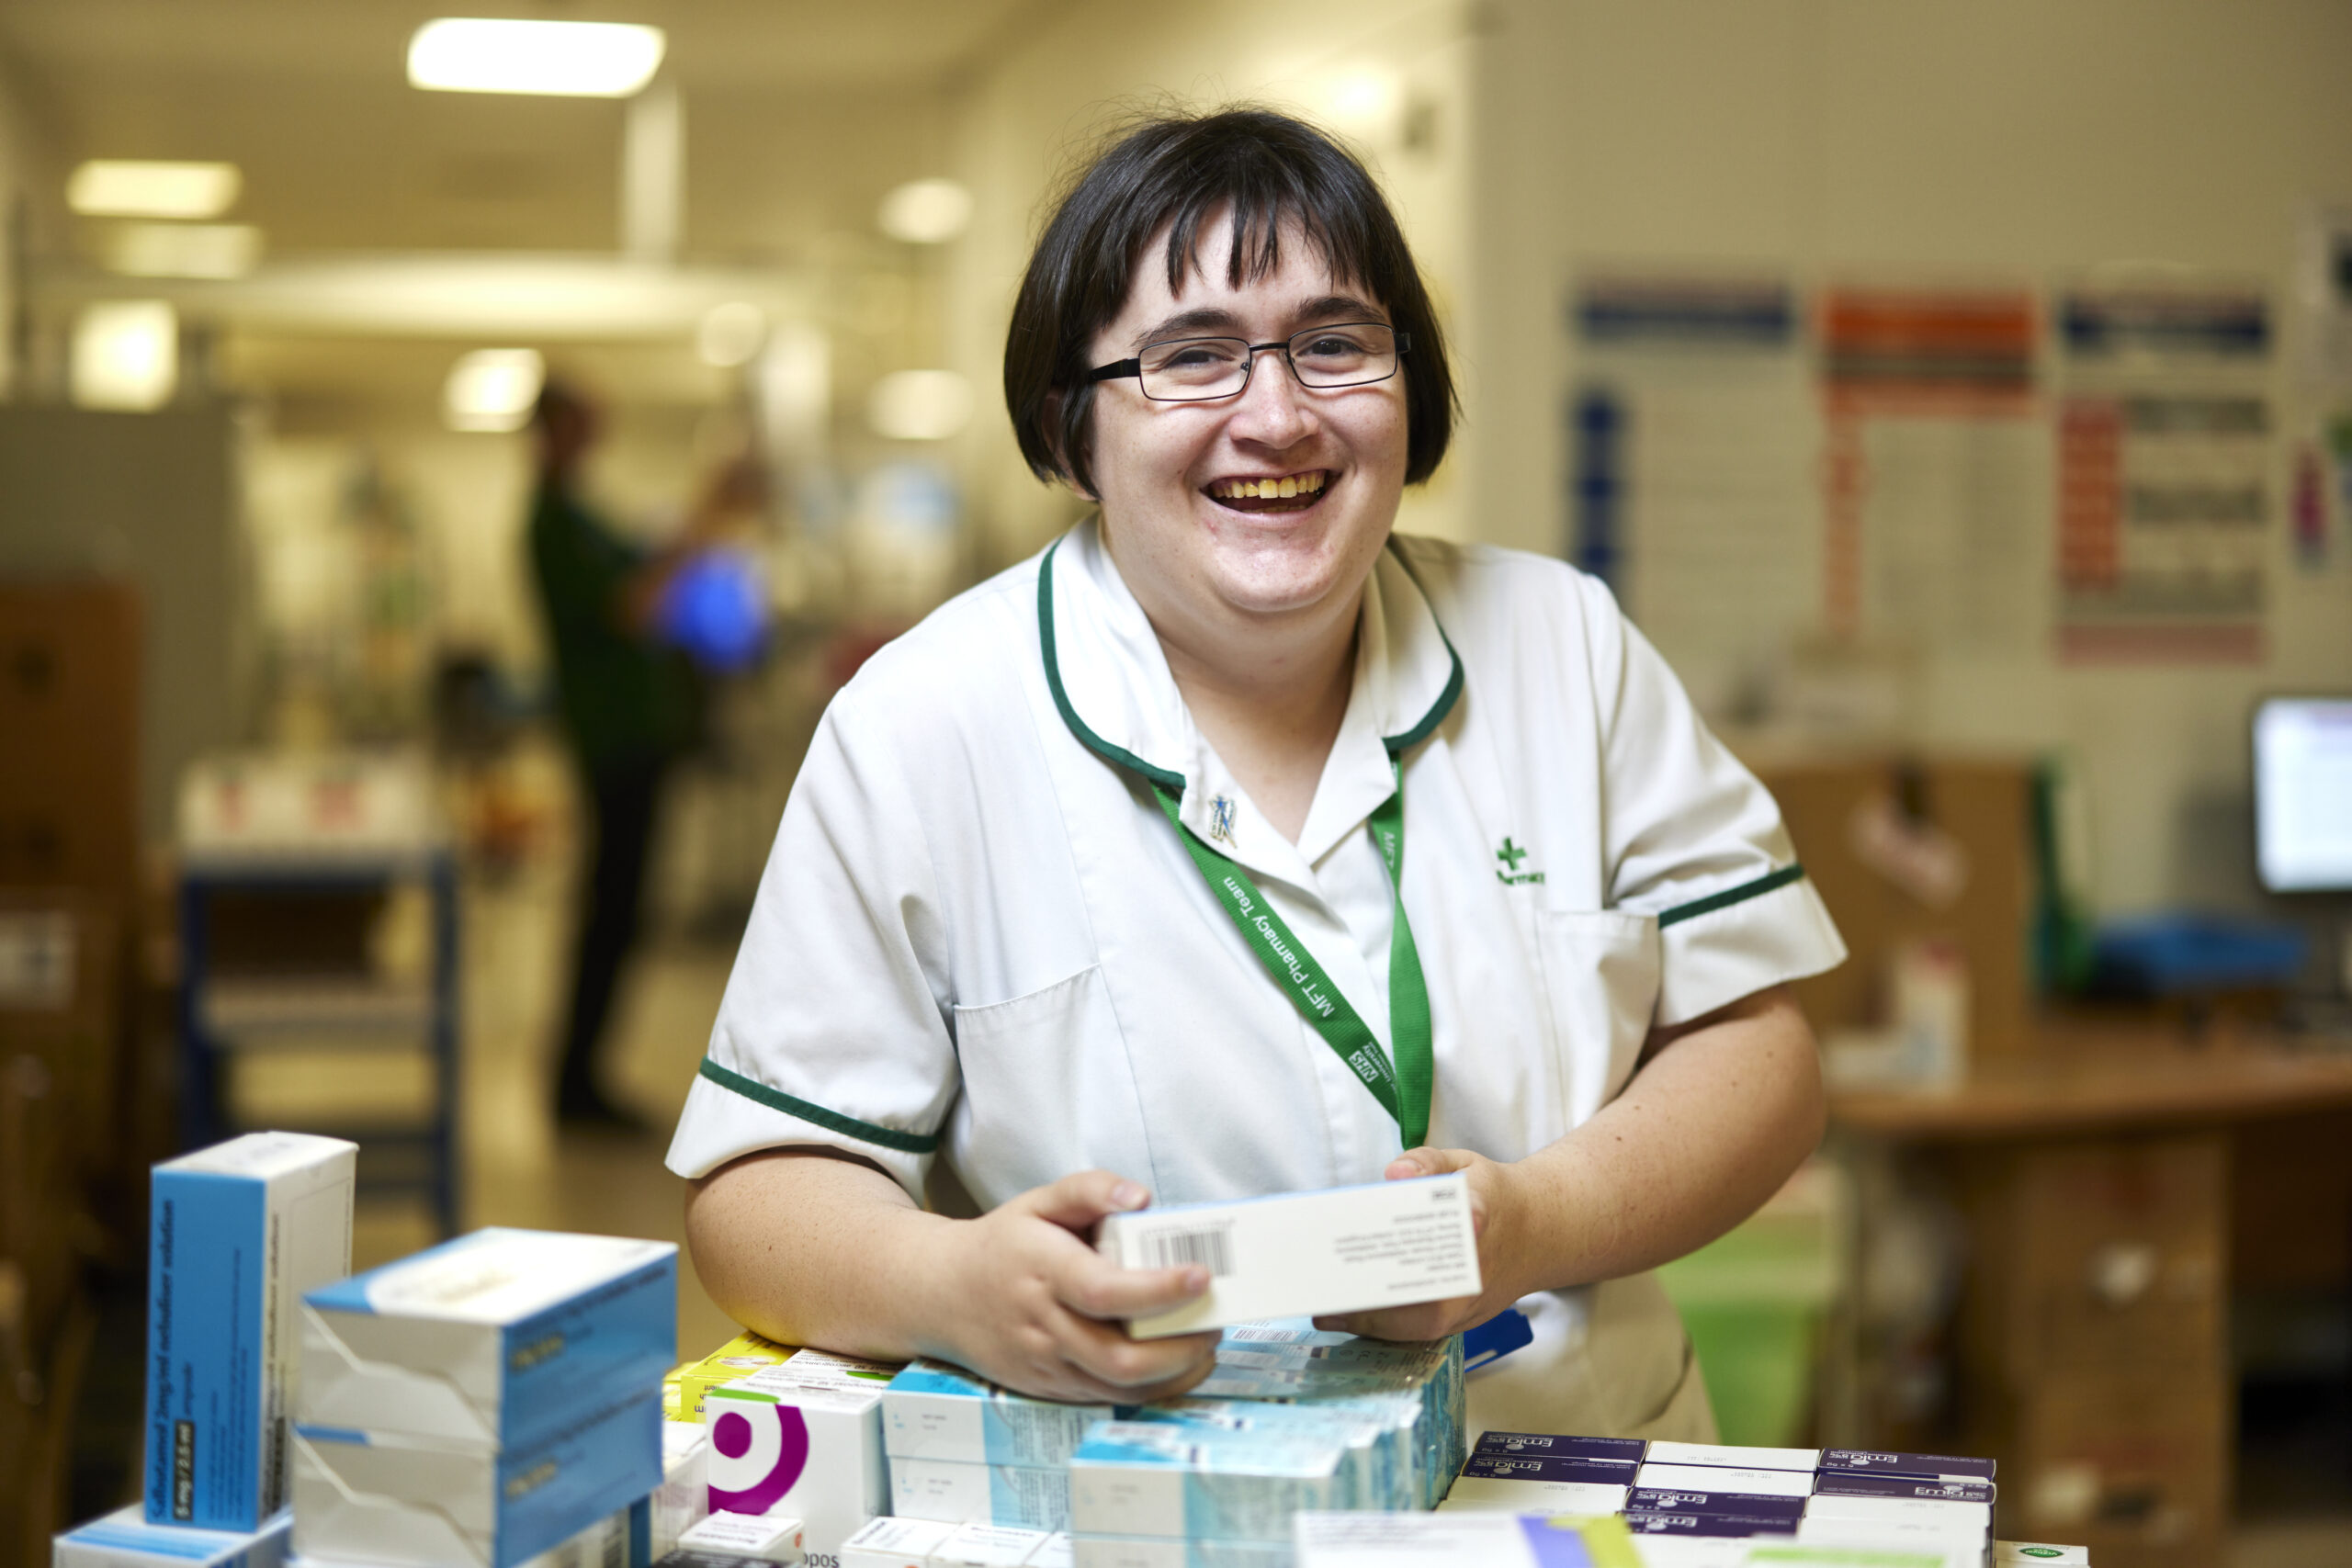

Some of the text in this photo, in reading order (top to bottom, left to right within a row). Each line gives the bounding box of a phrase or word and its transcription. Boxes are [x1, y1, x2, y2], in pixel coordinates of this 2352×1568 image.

[1224, 875, 1255, 917] Team
[1252, 914, 1309, 985] Pharmacy
[1302, 987, 1335, 1018] MFT
[1350, 1052, 1378, 1082] NHS
[153, 1200, 175, 1519] Salbutamol 2mg/ml nebuliser solution
[1507, 1438, 1553, 1448] Emla
[1495, 1461, 1542, 1472] Emla
[1850, 1455, 1898, 1463] Emla
[1658, 1494, 1707, 1505] Emla
[1915, 1486, 1963, 1495] Emla
